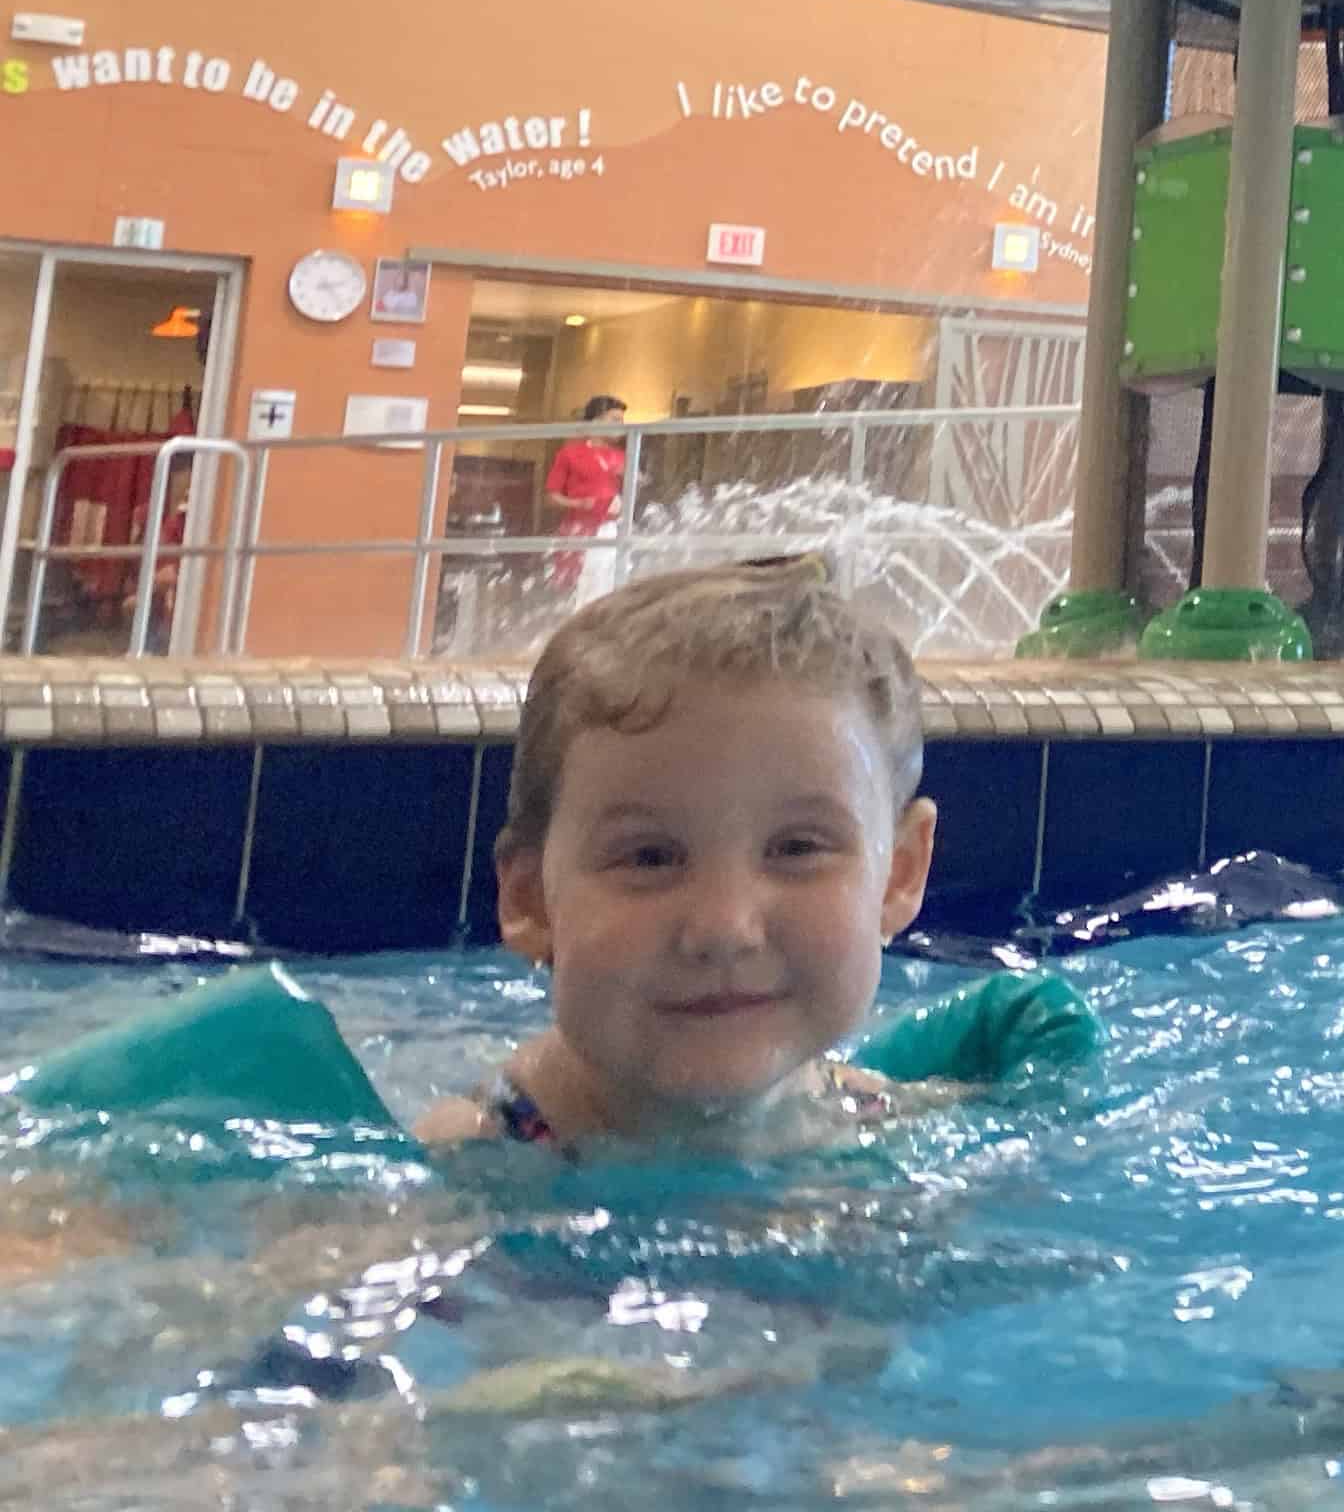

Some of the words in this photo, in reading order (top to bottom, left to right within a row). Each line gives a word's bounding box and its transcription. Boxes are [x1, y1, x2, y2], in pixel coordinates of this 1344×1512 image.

[52, 45, 175, 91] want
[183, 50, 231, 92] to
[242, 59, 299, 112] be
[307, 89, 355, 140] in
[362, 119, 432, 183] the
[712, 81, 784, 120] like
[794, 74, 836, 111] to
[838, 99, 979, 181] pretend
[1008, 183, 1056, 226] am
[549, 159, 586, 179] age
[719, 230, 755, 257] EXIT
